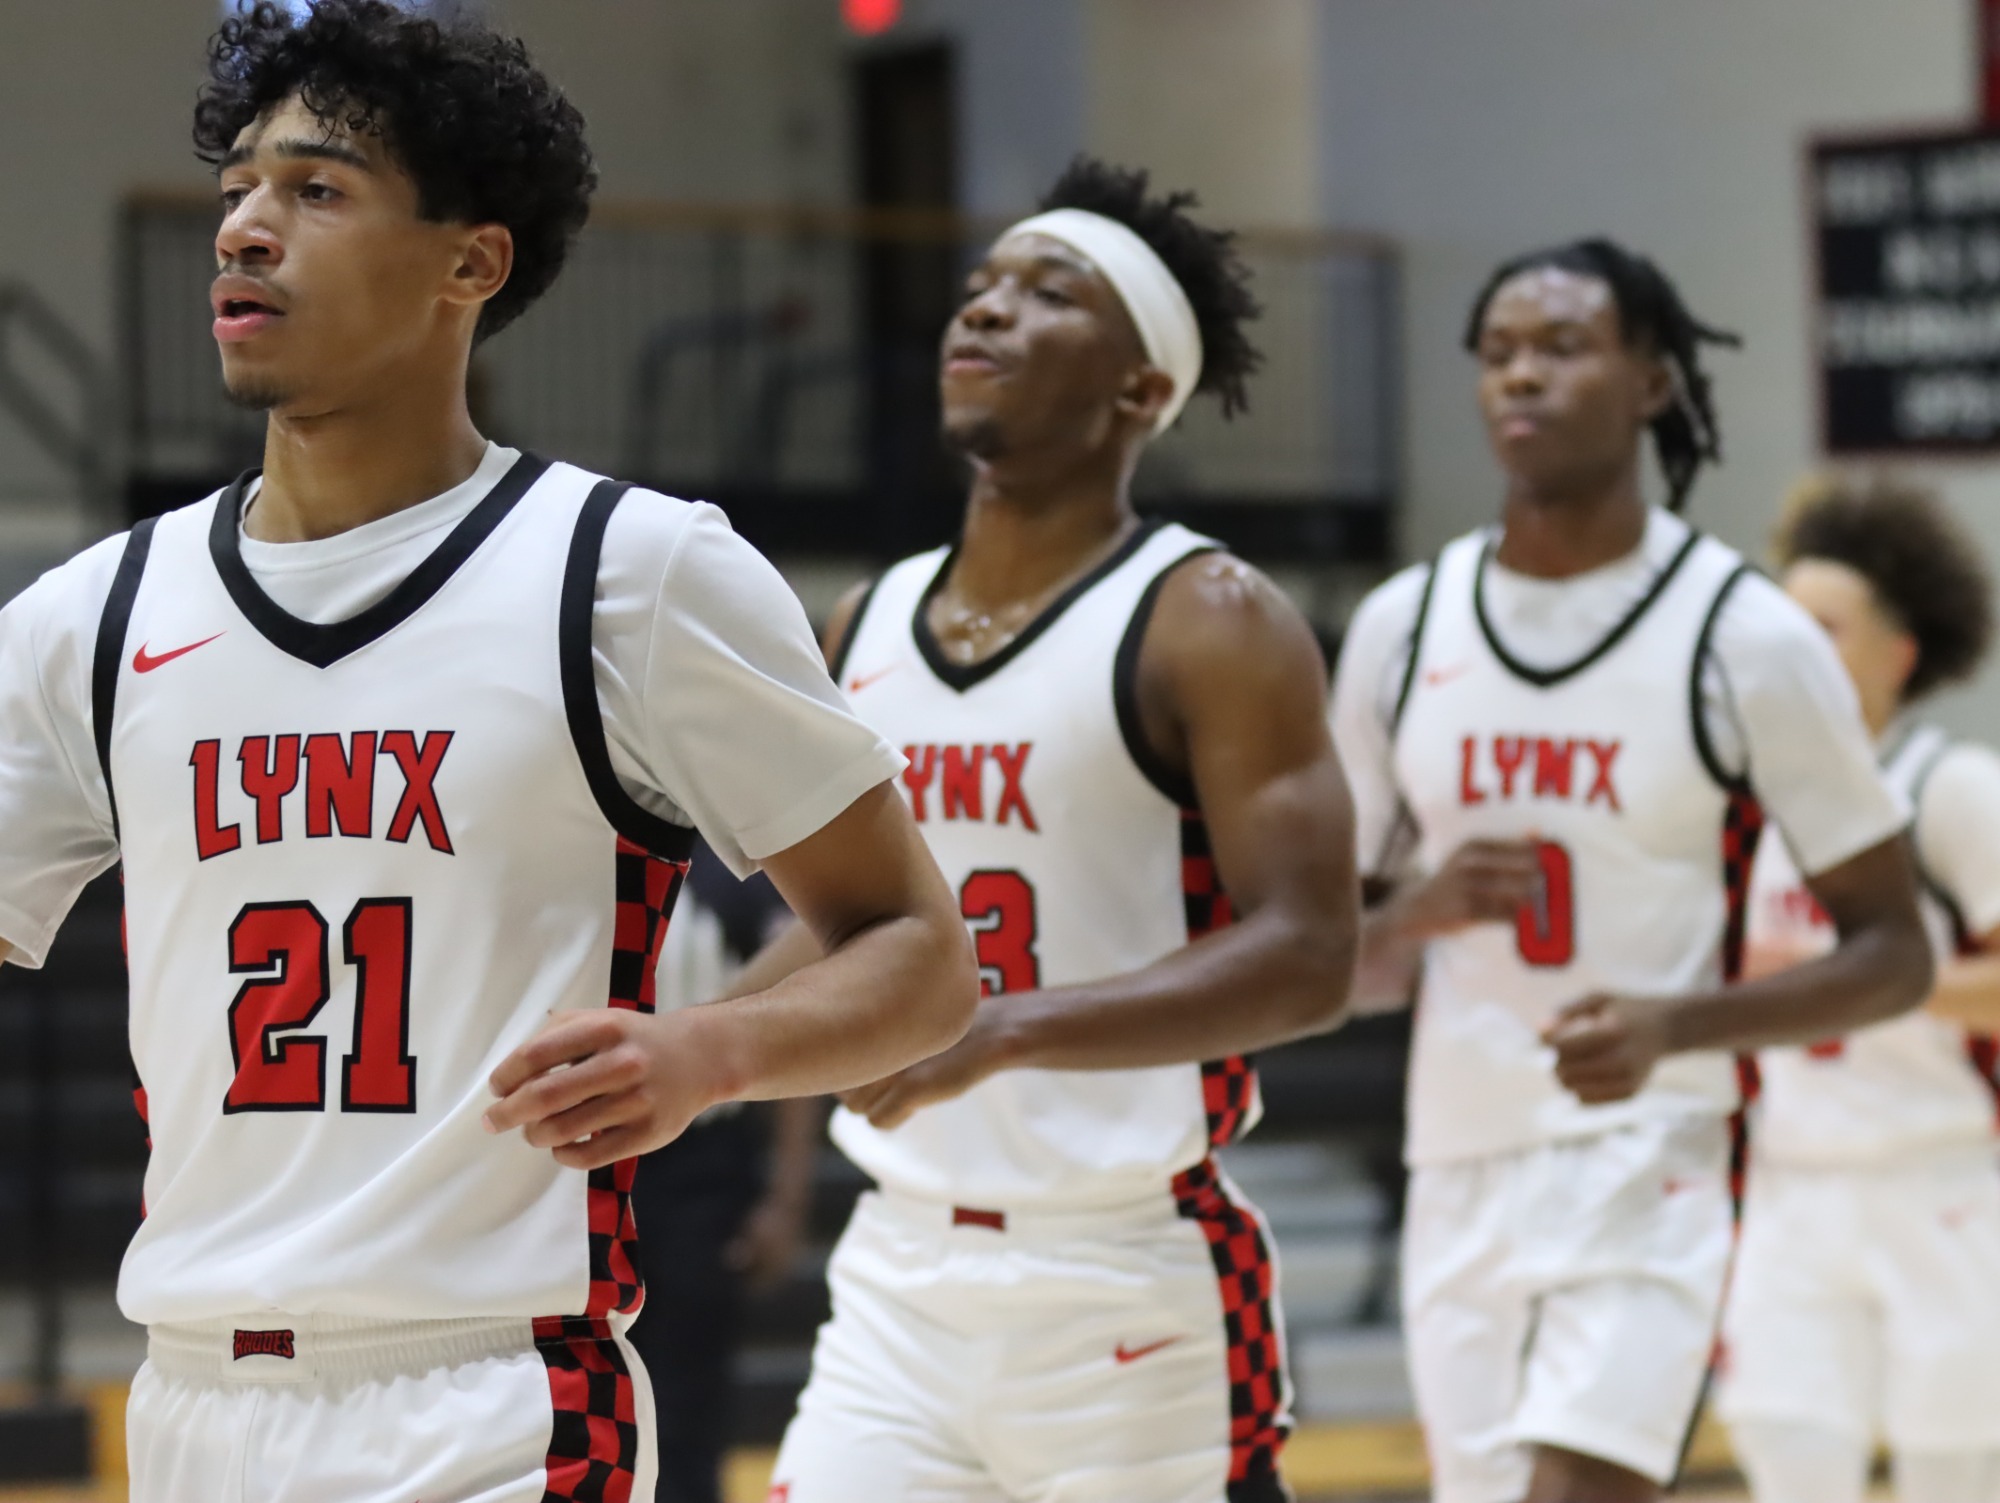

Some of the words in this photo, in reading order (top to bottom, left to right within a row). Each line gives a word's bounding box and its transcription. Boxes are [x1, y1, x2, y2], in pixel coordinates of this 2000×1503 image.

[189, 730, 455, 862] LYNX
[902, 740, 1041, 834] YNX
[1459, 734, 1624, 813] LYNX
[961, 868, 1040, 998] 3
[223, 896, 417, 1115] 21
[233, 1329, 295, 1361] RHODES
